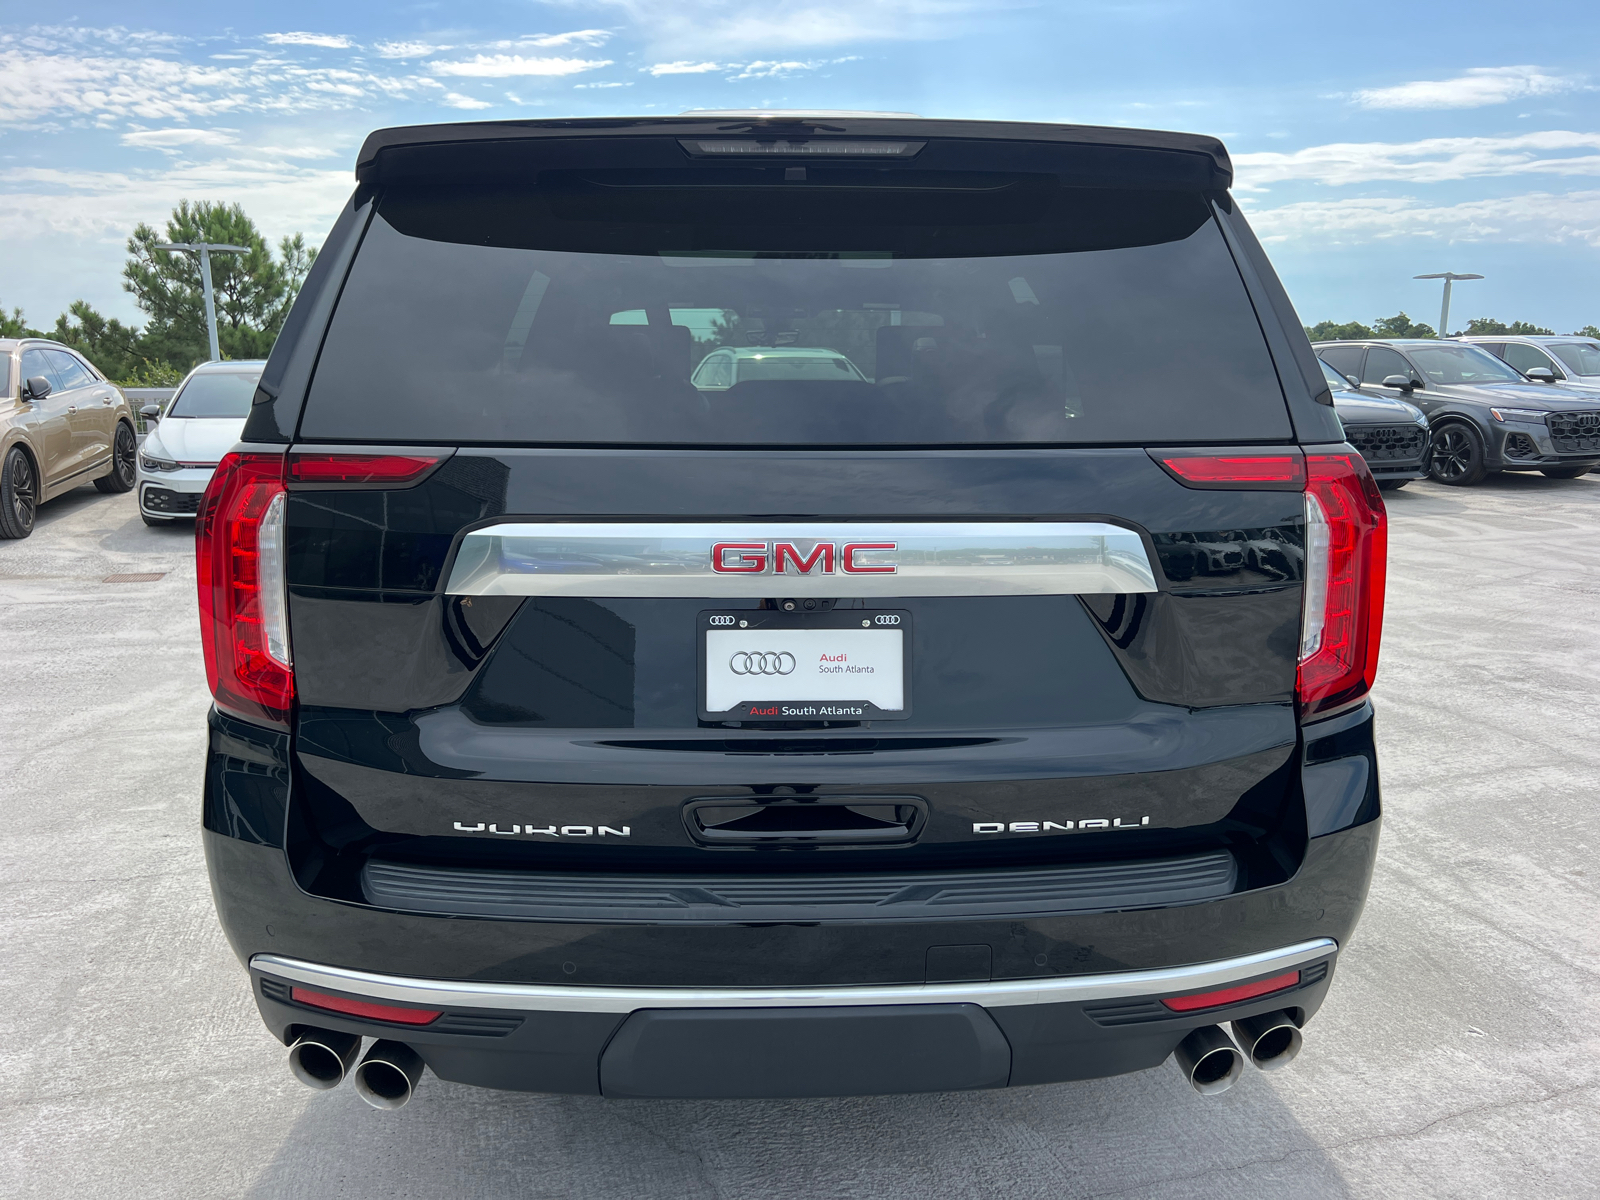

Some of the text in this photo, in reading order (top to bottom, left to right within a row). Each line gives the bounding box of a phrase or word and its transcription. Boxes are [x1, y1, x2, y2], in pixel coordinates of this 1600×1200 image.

[711, 541, 898, 575] GMC
[819, 653, 847, 662] Audi
[818, 665, 875, 674] South Atlanta
[749, 706, 863, 716] Audi South Atlanta
[453, 821, 631, 837] YUKON
[972, 815, 1150, 834] DENALI
